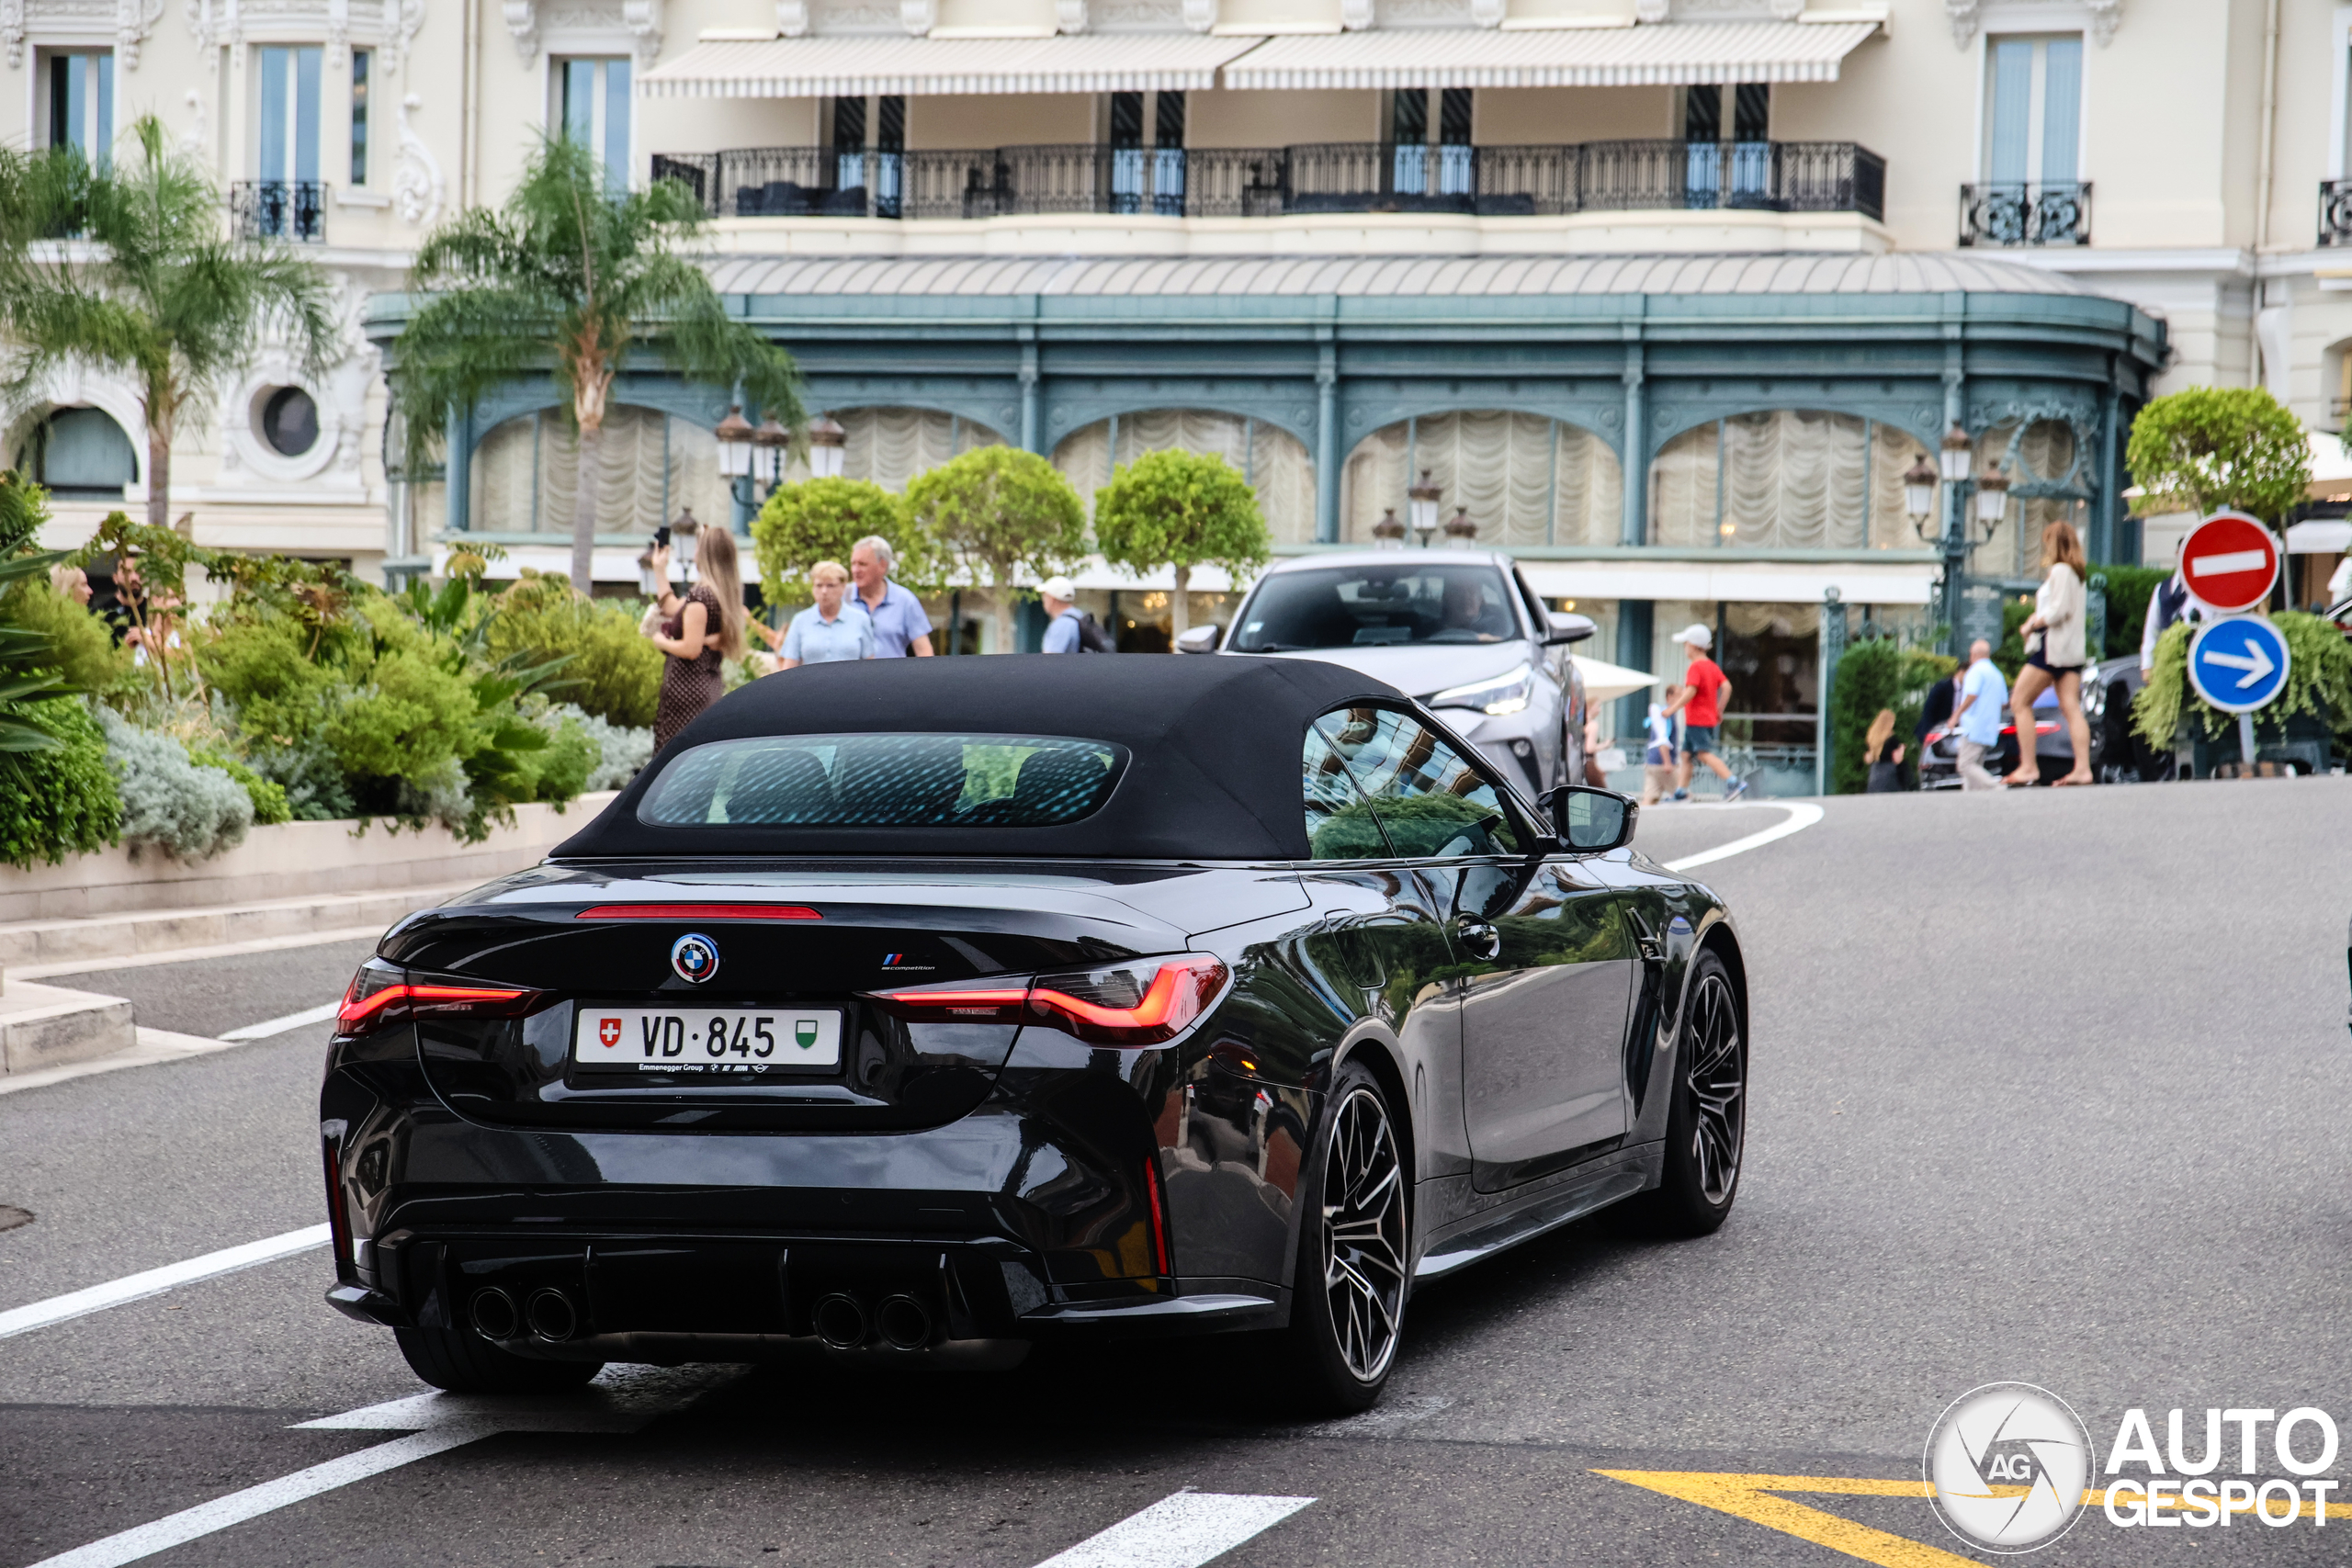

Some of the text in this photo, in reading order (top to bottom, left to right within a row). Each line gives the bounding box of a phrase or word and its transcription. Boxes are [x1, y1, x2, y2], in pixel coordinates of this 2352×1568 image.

[681, 943, 707, 955] BMW
[639, 1063, 704, 1073] Emmenegger Group
